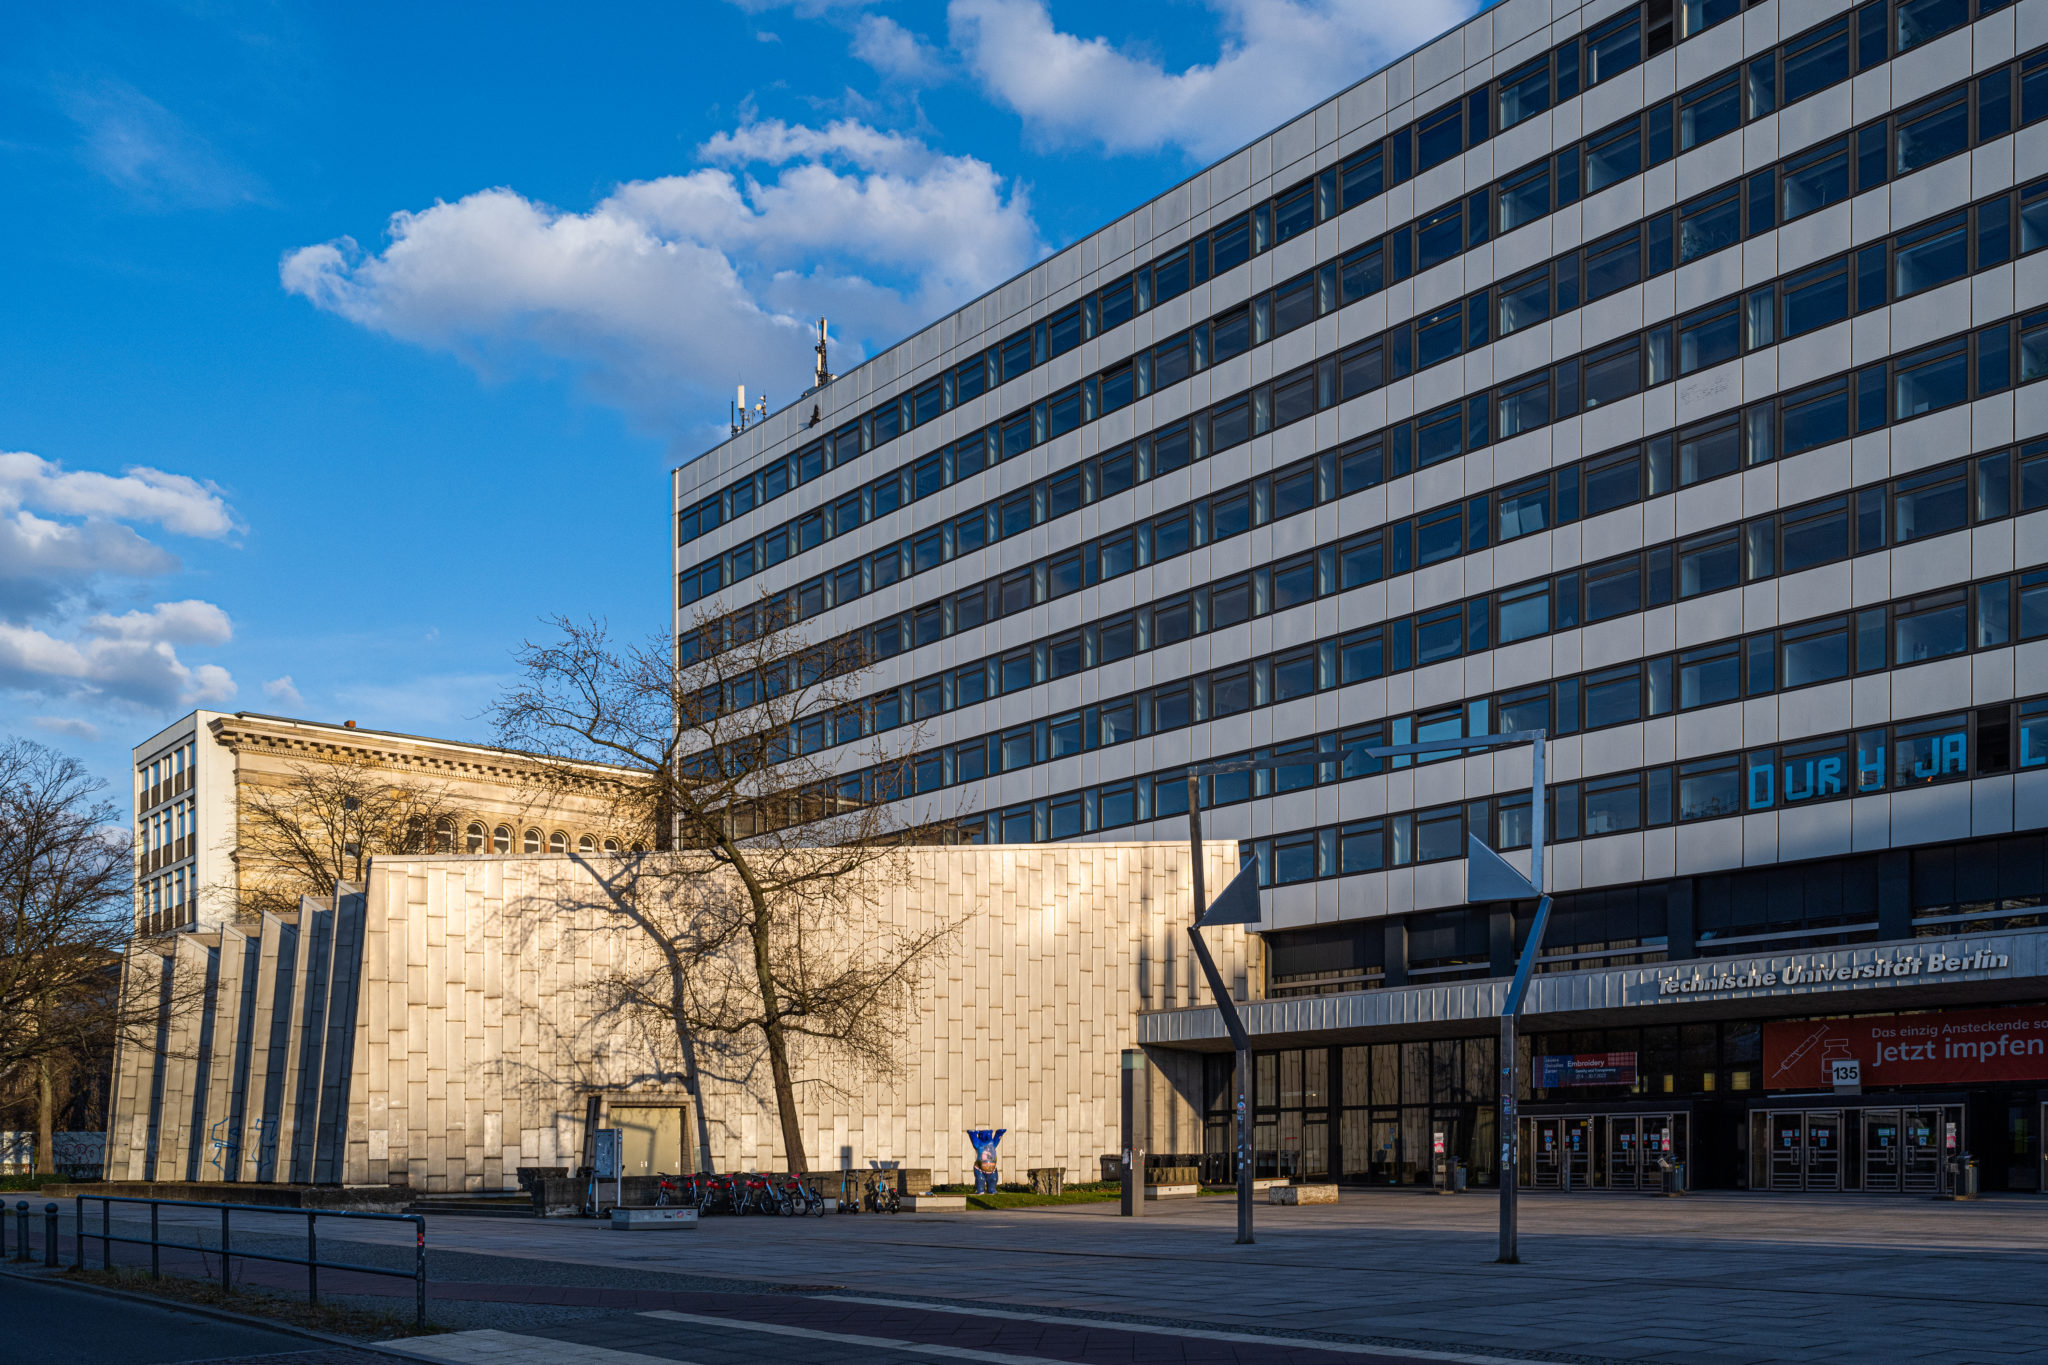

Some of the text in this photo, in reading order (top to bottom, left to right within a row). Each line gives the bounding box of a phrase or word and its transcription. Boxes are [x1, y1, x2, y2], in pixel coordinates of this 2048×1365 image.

[1658, 949, 2009, 995] Technische Universität Berlin
[1871, 1027, 1897, 1039] Das
[1899, 1024, 1938, 1038] einzig
[1941, 1019, 2030, 1035] Ansteckende
[1872, 1034, 2044, 1067] Jetzt impfen
[1567, 1059, 1605, 1068] Embroidery
[1833, 1066, 1858, 1080] 135
